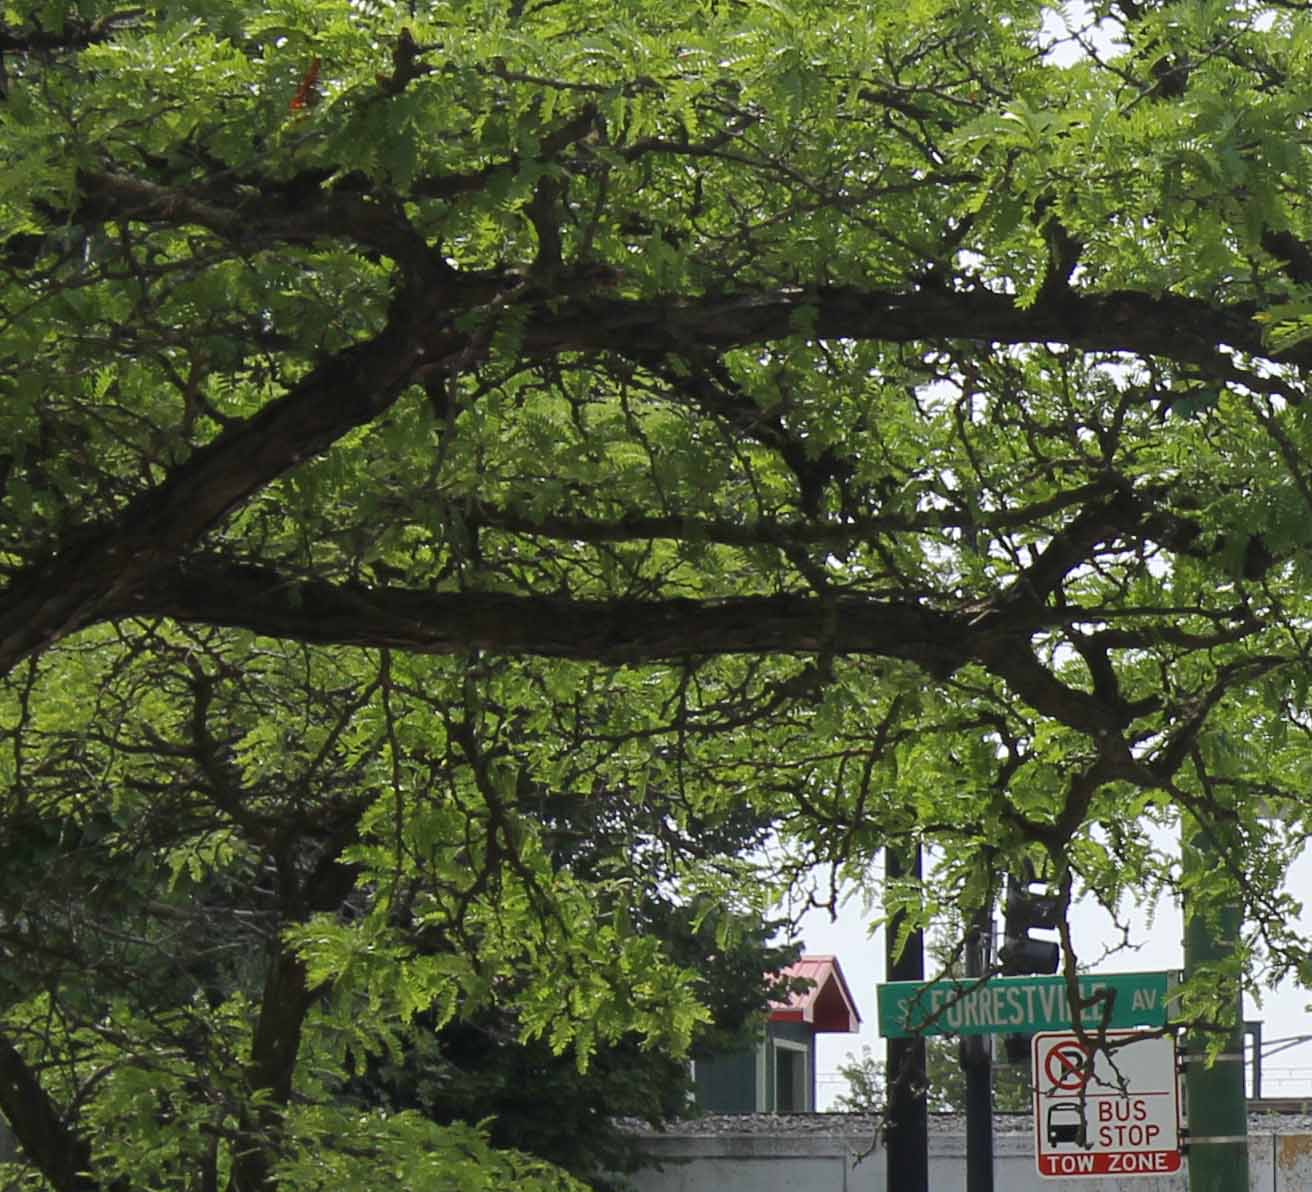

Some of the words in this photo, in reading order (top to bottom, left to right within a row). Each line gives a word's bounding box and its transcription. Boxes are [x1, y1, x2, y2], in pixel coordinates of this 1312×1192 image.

[1131, 988, 1157, 1011] AV
[1098, 1100, 1147, 1122] BUS
[1099, 1125, 1159, 1147] STOP
[1047, 1154, 1094, 1173] TOW
[1108, 1152, 1169, 1172] ZONE
